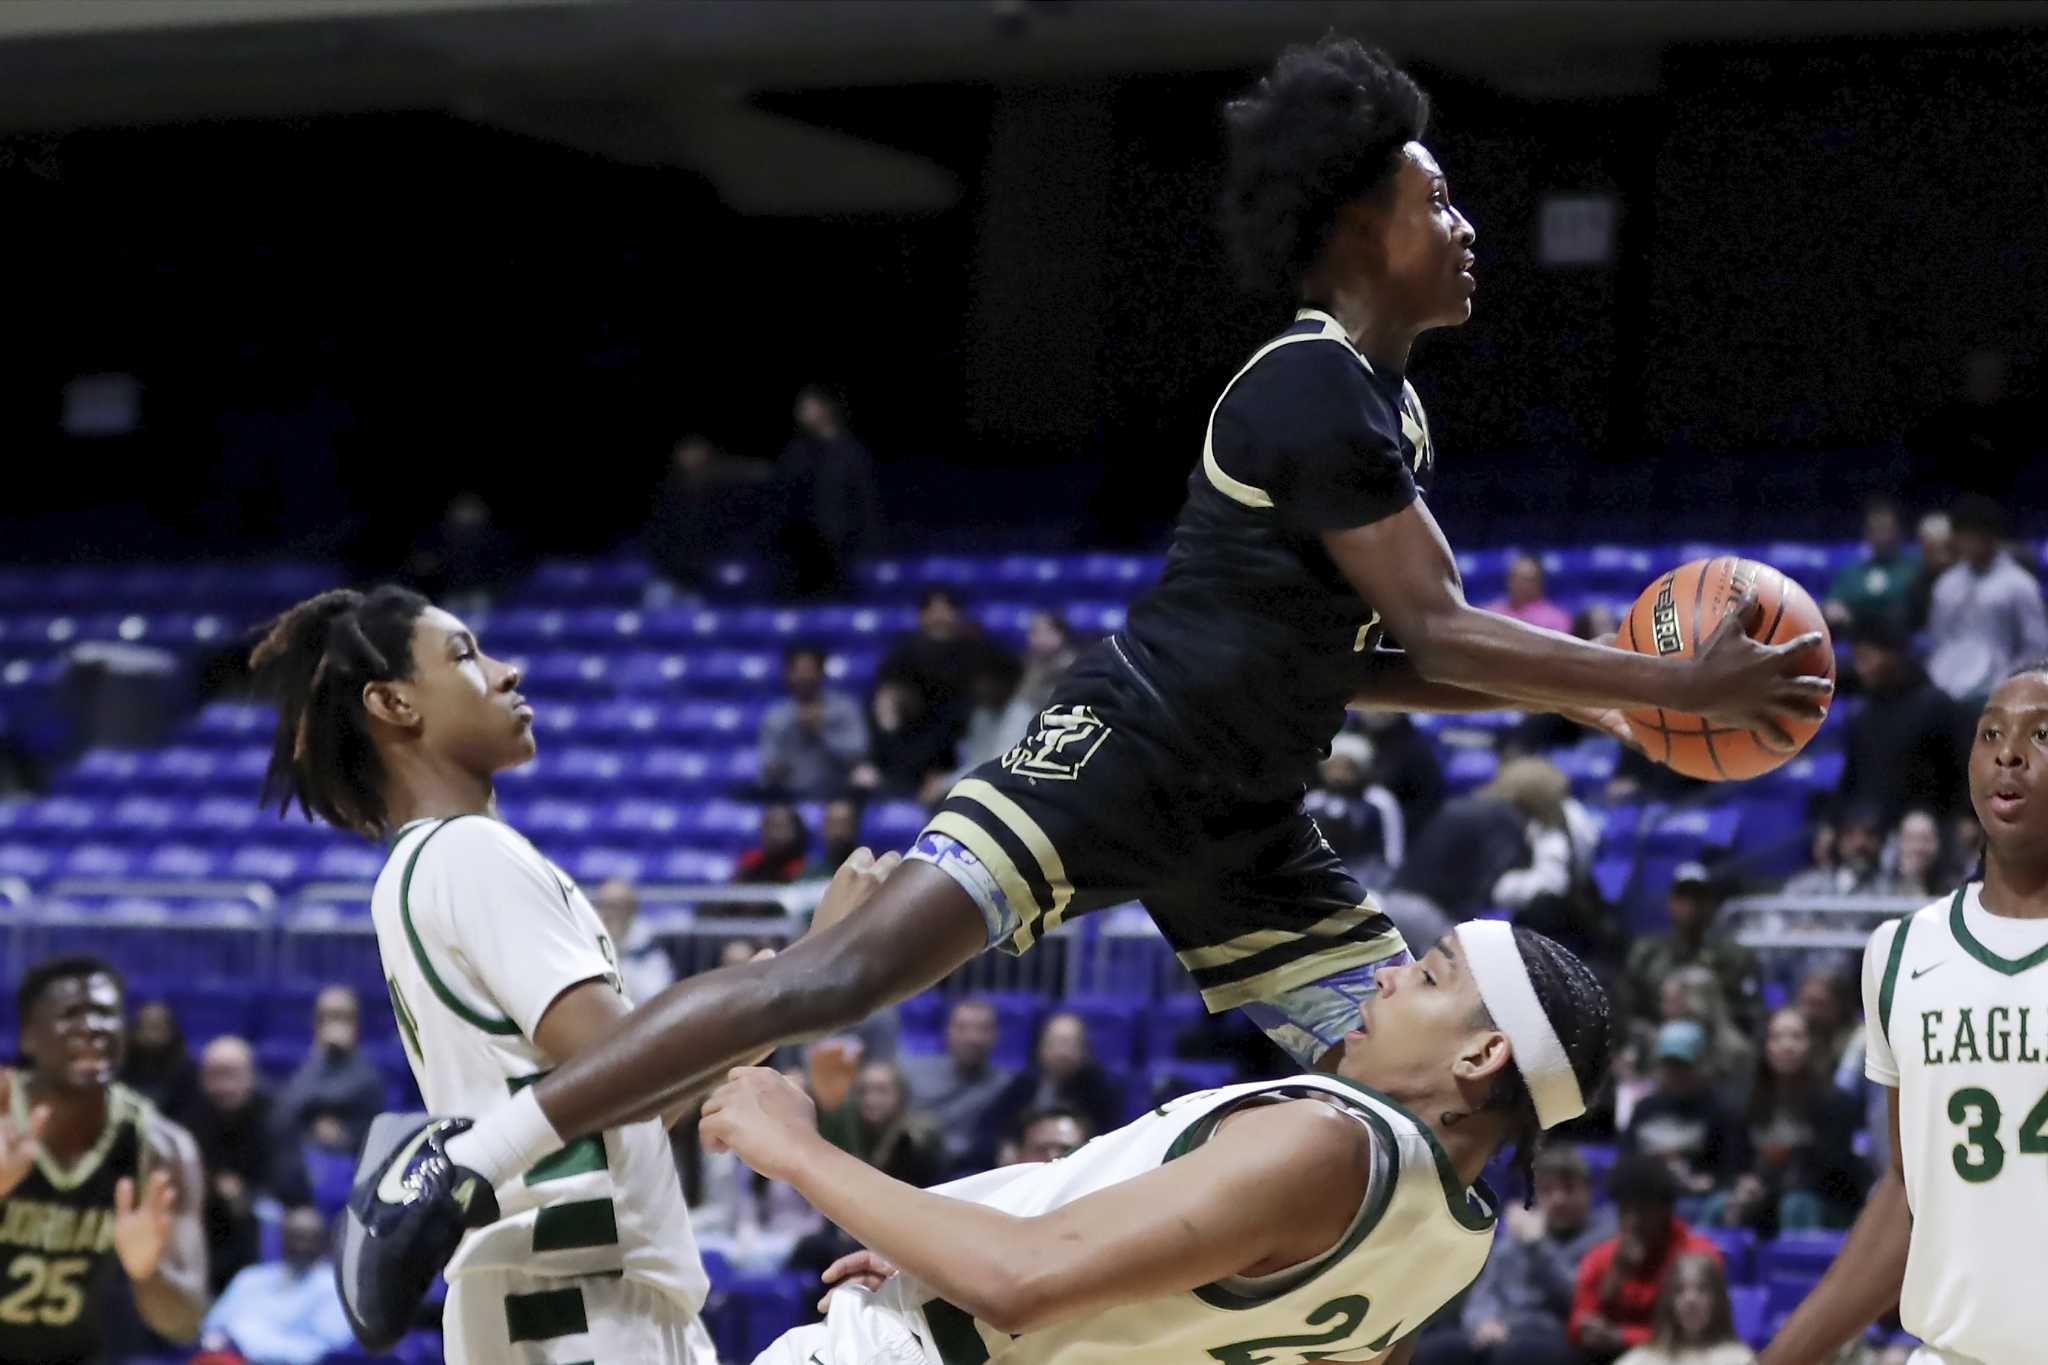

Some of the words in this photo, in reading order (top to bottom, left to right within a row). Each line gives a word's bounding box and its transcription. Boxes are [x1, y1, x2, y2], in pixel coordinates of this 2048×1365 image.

[1655, 605, 1680, 654] PRO
[1920, 1006, 2048, 1066] EAGL
[0, 1256, 88, 1325] 25
